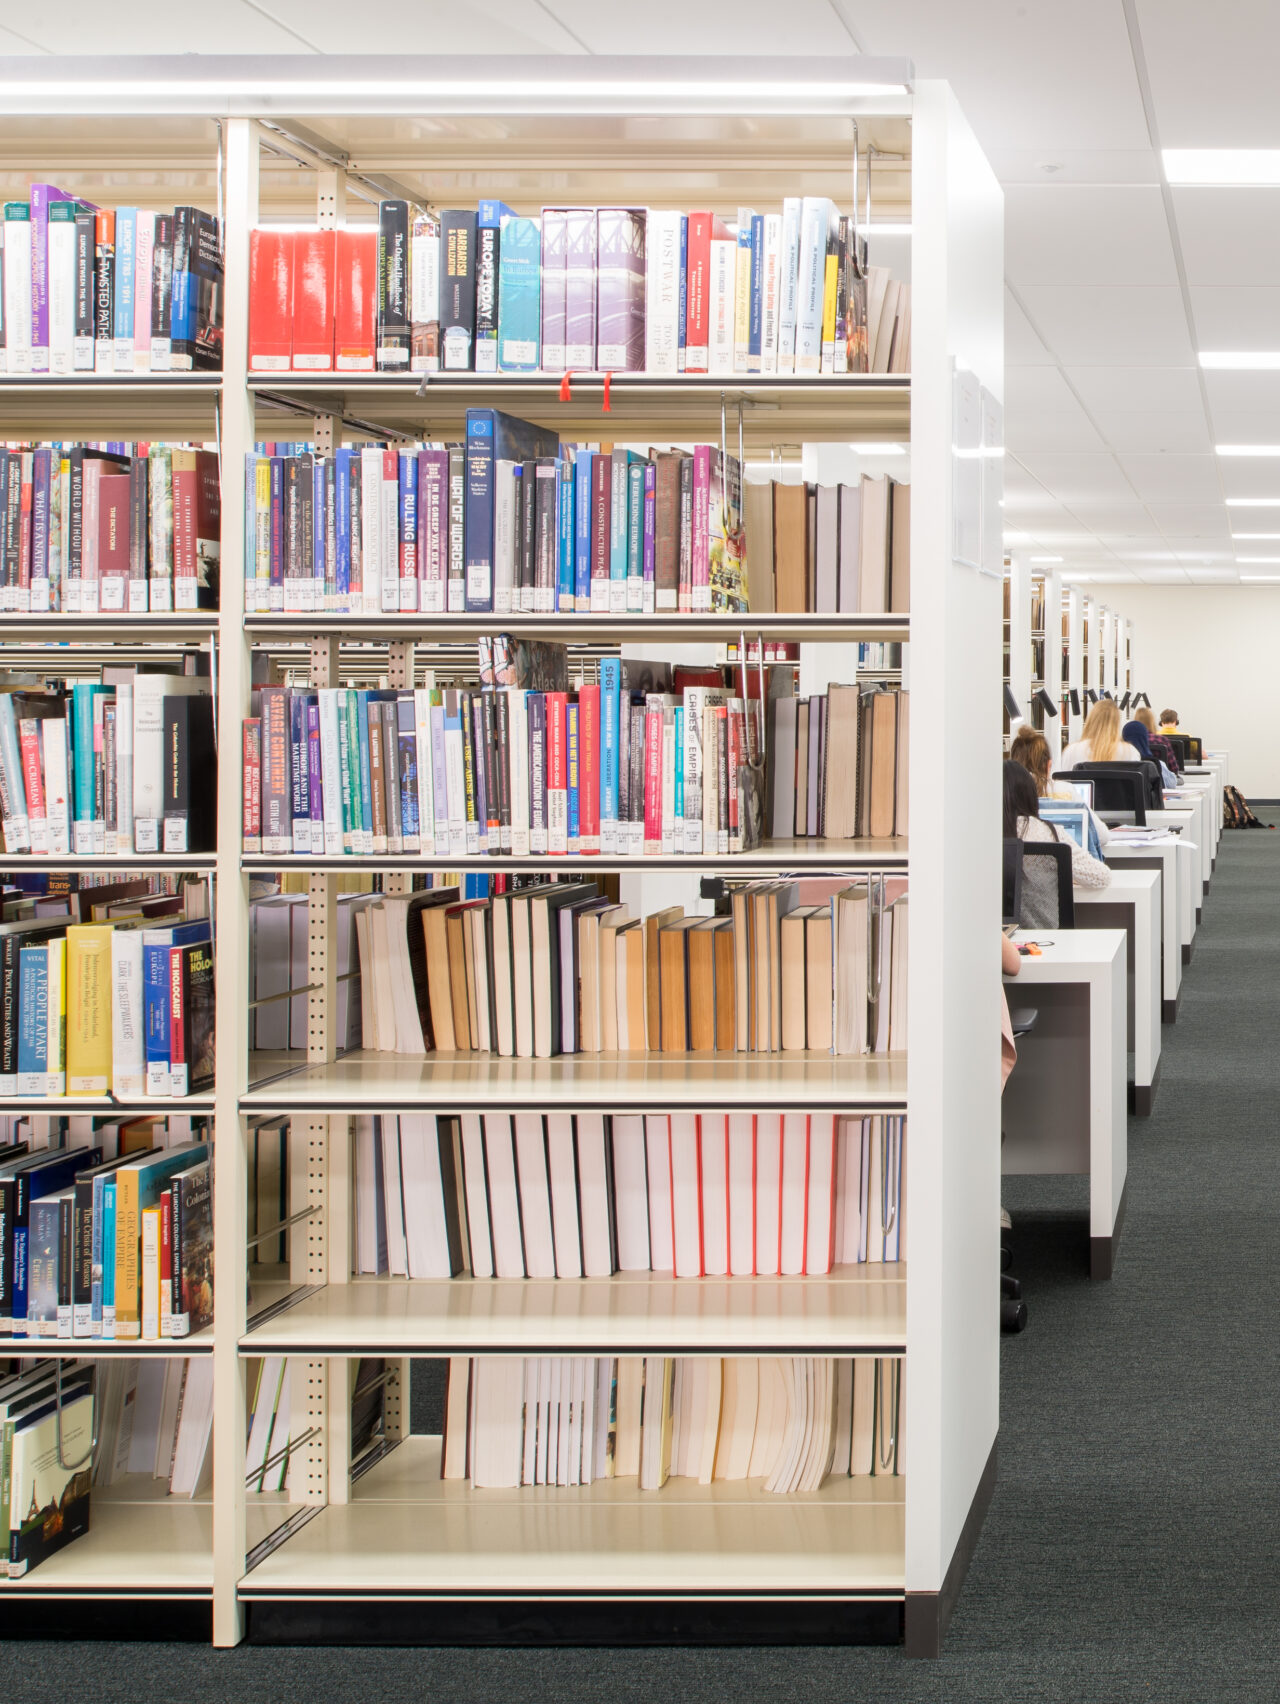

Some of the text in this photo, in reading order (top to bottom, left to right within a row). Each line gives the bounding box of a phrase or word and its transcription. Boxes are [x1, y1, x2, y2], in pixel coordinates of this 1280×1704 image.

[123, 220, 133, 256] EUROPE
[448, 236, 456, 276] CIVILIZATION
[457, 229, 467, 276] BARBARISM
[123, 257, 133, 276] 1783
[394, 233, 403, 315] The Oxford Handbook of
[481, 230, 493, 319] EUROPE TODAY
[663, 230, 674, 302] POSTWAR
[788, 252, 796, 284] POLITICAL
[810, 254, 818, 285] POLITICAL
[100, 262, 110, 341] TWISTED PATHS
[123, 286, 133, 303] 1914
[788, 286, 796, 311] PROFILE
[810, 287, 818, 312] PROFILE
[35, 491, 45, 521] WHAT
[73, 476, 82, 507] WORLD
[432, 484, 439, 492] IN
[432, 495, 439, 504] DE
[73, 512, 82, 552] WITHOUT
[406, 495, 416, 540] RULING
[452, 505, 463, 523] OF
[632, 482, 640, 553] REBUILDING EUROPE
[432, 552, 439, 562] DE
[452, 524, 463, 570] WORDS
[73, 557, 82, 578] JEW
[689, 694, 697, 732] CRISES
[271, 694, 285, 794] SAVAGE CONTINENT
[533, 730, 543, 809] THE AMERICANIZATION OF
[689, 747, 697, 786] EMPIRE
[29, 767, 40, 804] CRIMEAN
[253, 806, 260, 814] ON
[270, 800, 280, 833] KEITH LOWE
[118, 961, 134, 1039] CLARK THE SLEEPWALKERS
[172, 954, 181, 1019] THE HOLOCAUST
[5, 996, 13, 1016] CITIES
[36, 968, 47, 1061] A PEOPLE APART
[5, 1018, 13, 1035] AND
[5, 1036, 13, 1070] WEALTH
[83, 1208, 92, 1288] The Crisis of Reason
[117, 1211, 125, 1269] OF EMPIRE
[127, 1211, 137, 1290] GEOGRAPHIES
